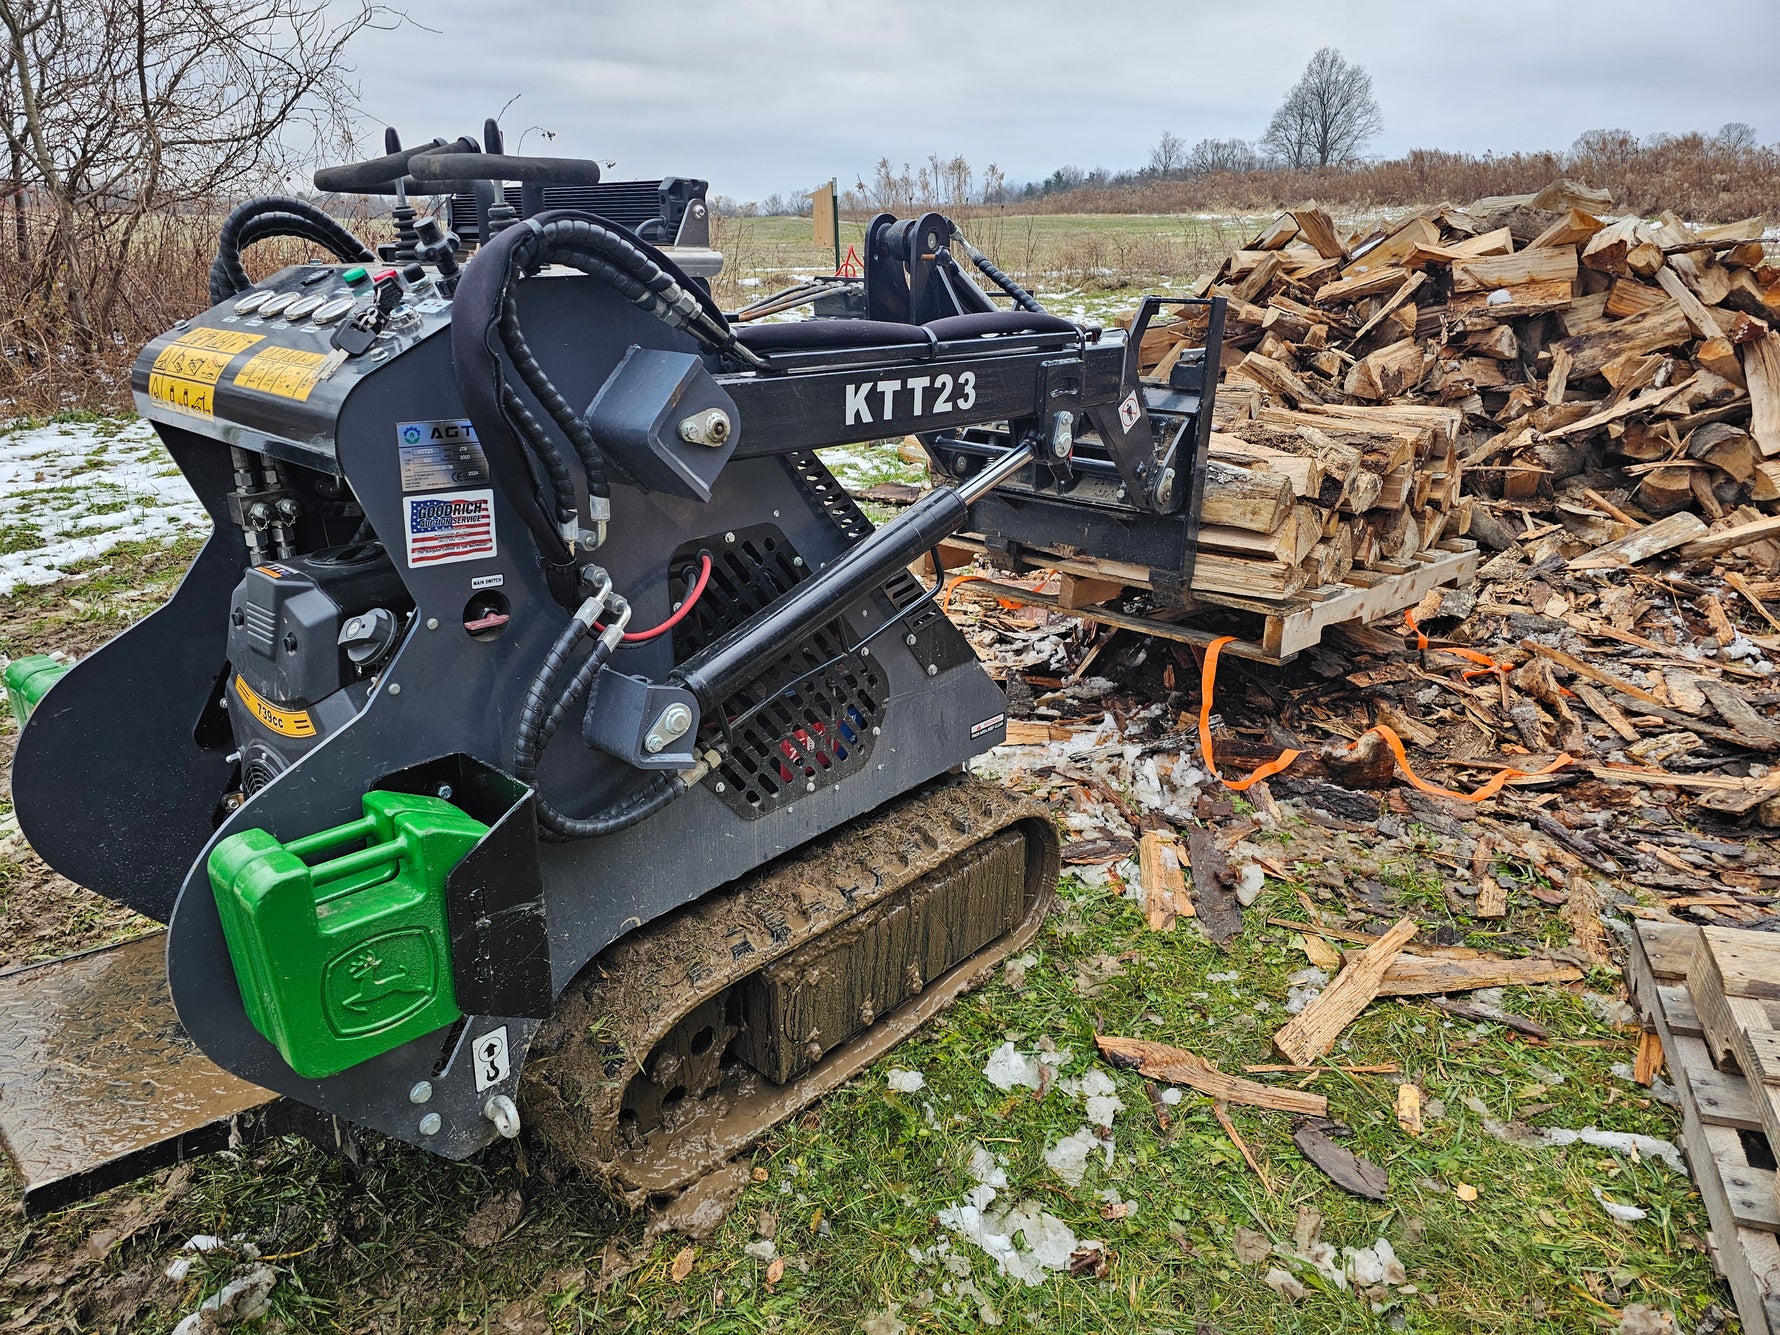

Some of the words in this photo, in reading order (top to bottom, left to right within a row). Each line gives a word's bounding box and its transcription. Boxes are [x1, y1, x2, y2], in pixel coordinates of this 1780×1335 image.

[845, 371, 976, 426] KTT23
[430, 425, 473, 440] AGT
[418, 501, 483, 519] GOODRICH
[420, 518, 451, 528] AUCTION
[452, 514, 482, 525] SERVICE
[485, 577, 502, 585] SWITCH
[257, 702, 284, 729] 739cc
